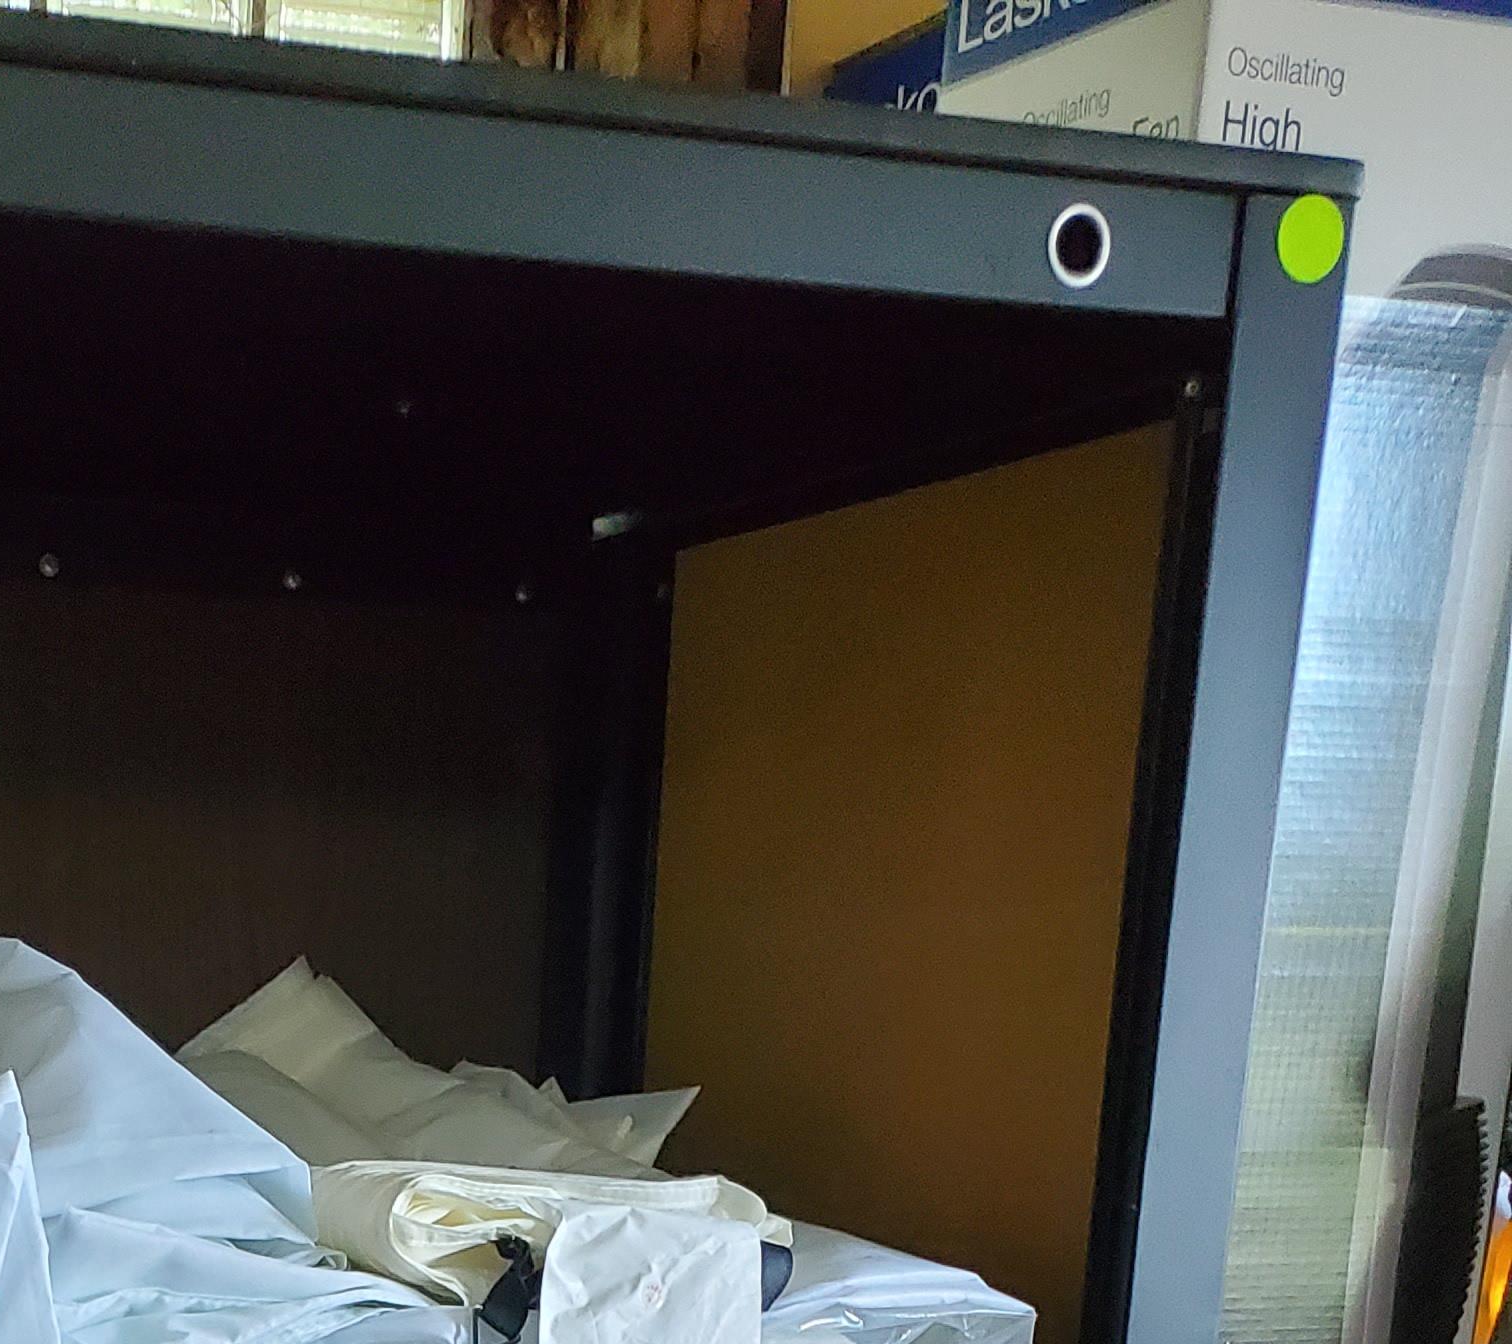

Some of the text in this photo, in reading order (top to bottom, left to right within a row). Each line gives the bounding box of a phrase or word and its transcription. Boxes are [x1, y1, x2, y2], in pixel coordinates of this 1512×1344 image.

[957, 0, 1090, 53] Las
[1228, 46, 1345, 97] Oscillating
[1222, 99, 1302, 151] High
